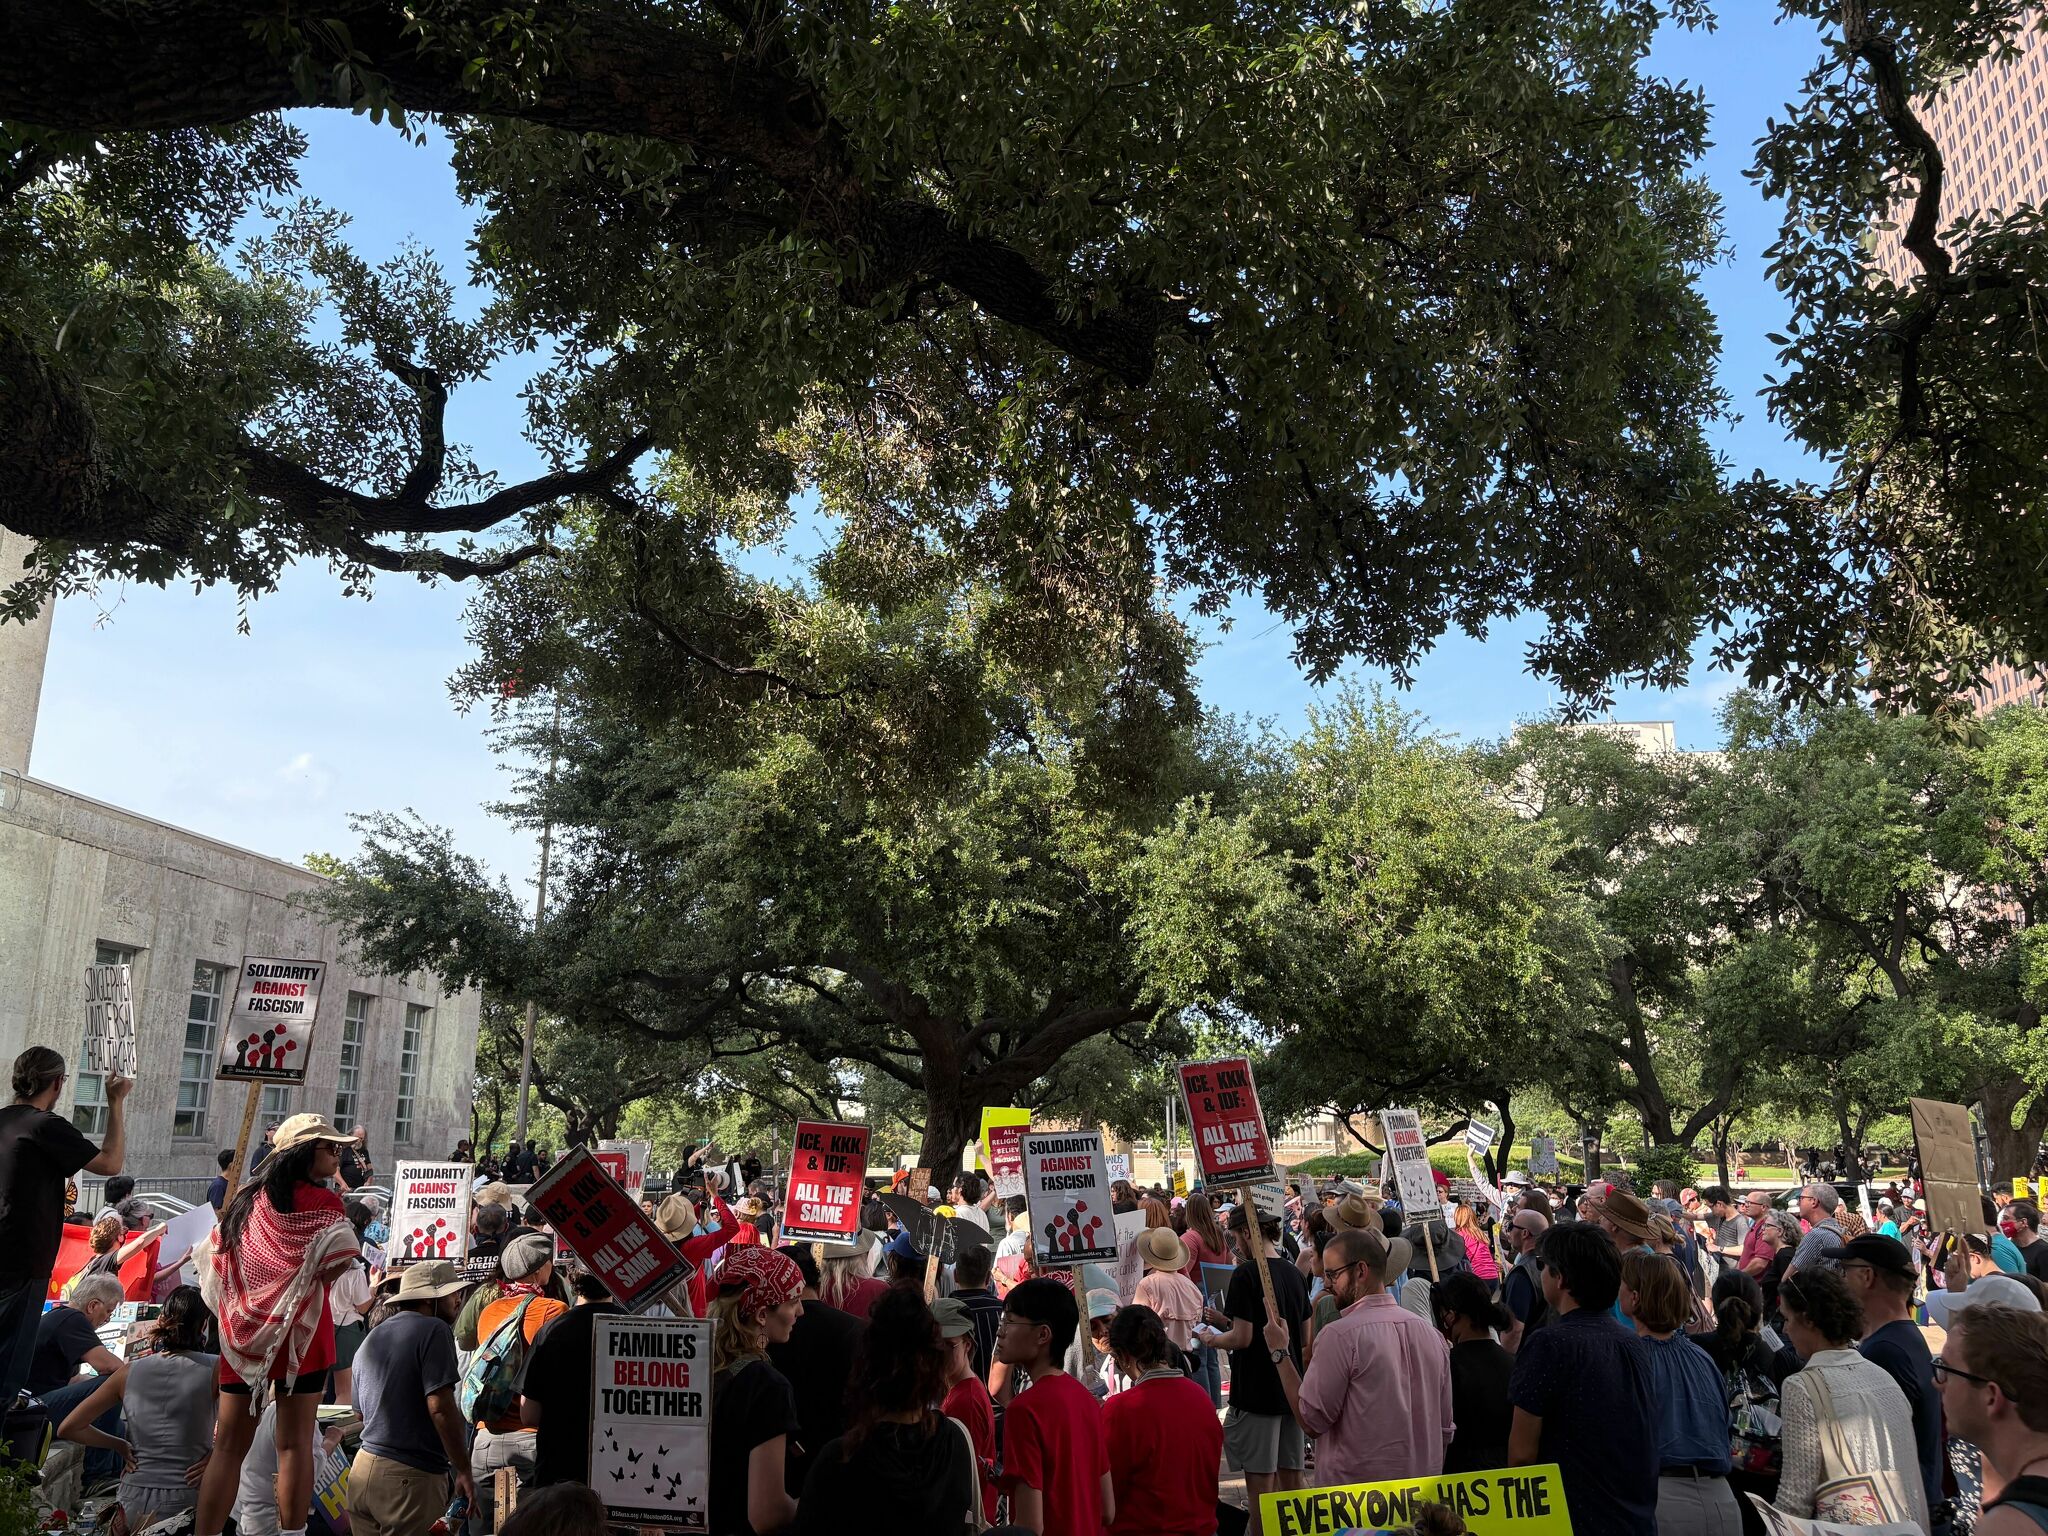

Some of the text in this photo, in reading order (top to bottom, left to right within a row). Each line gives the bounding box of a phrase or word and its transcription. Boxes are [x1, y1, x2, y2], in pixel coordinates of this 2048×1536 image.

[247, 963, 320, 980] SOLIDARITY
[252, 981, 307, 997] AGAINST
[247, 998, 304, 1014] FASCISM
[85, 1002, 134, 1039] UNIVERSAL
[1203, 1090, 1246, 1113] & IDF:
[1387, 1114, 1417, 1130] FAMILIES
[797, 1133, 825, 1153] ICE,
[992, 1138, 1018, 1146] RELIGIO
[1202, 1121, 1259, 1146] ALL THE
[1393, 1130, 1420, 1146] BELONG
[996, 1147, 1020, 1155] BELIEV
[1028, 1137, 1098, 1155] SOLIDARITY
[1214, 1141, 1257, 1166] SAME
[807, 1154, 851, 1174] & IDF:
[1040, 1155, 1092, 1173] AGAINST
[402, 1168, 466, 1180] SOLIDARITY
[1041, 1174, 1096, 1191] FASCISM
[409, 1182, 457, 1194] AGAINST
[795, 1183, 854, 1205] ALL THE
[1254, 1184, 1285, 1195] TITUTION
[407, 1197, 456, 1210] FASCISM
[544, 1196, 578, 1225] ICE,
[574, 1200, 618, 1239] & IDF:
[800, 1203, 844, 1224] SAME
[592, 1221, 650, 1274] ALL THE
[467, 1261, 497, 1270] OTECTI
[469, 1255, 499, 1264] ECTIO
[615, 1247, 661, 1289] SAME
[608, 1331, 697, 1360] FAMILIES
[614, 1360, 690, 1388] BELONG
[601, 1388, 703, 1417] TOGETHER
[1276, 1475, 1552, 1536] EVERYONE HAS THE
